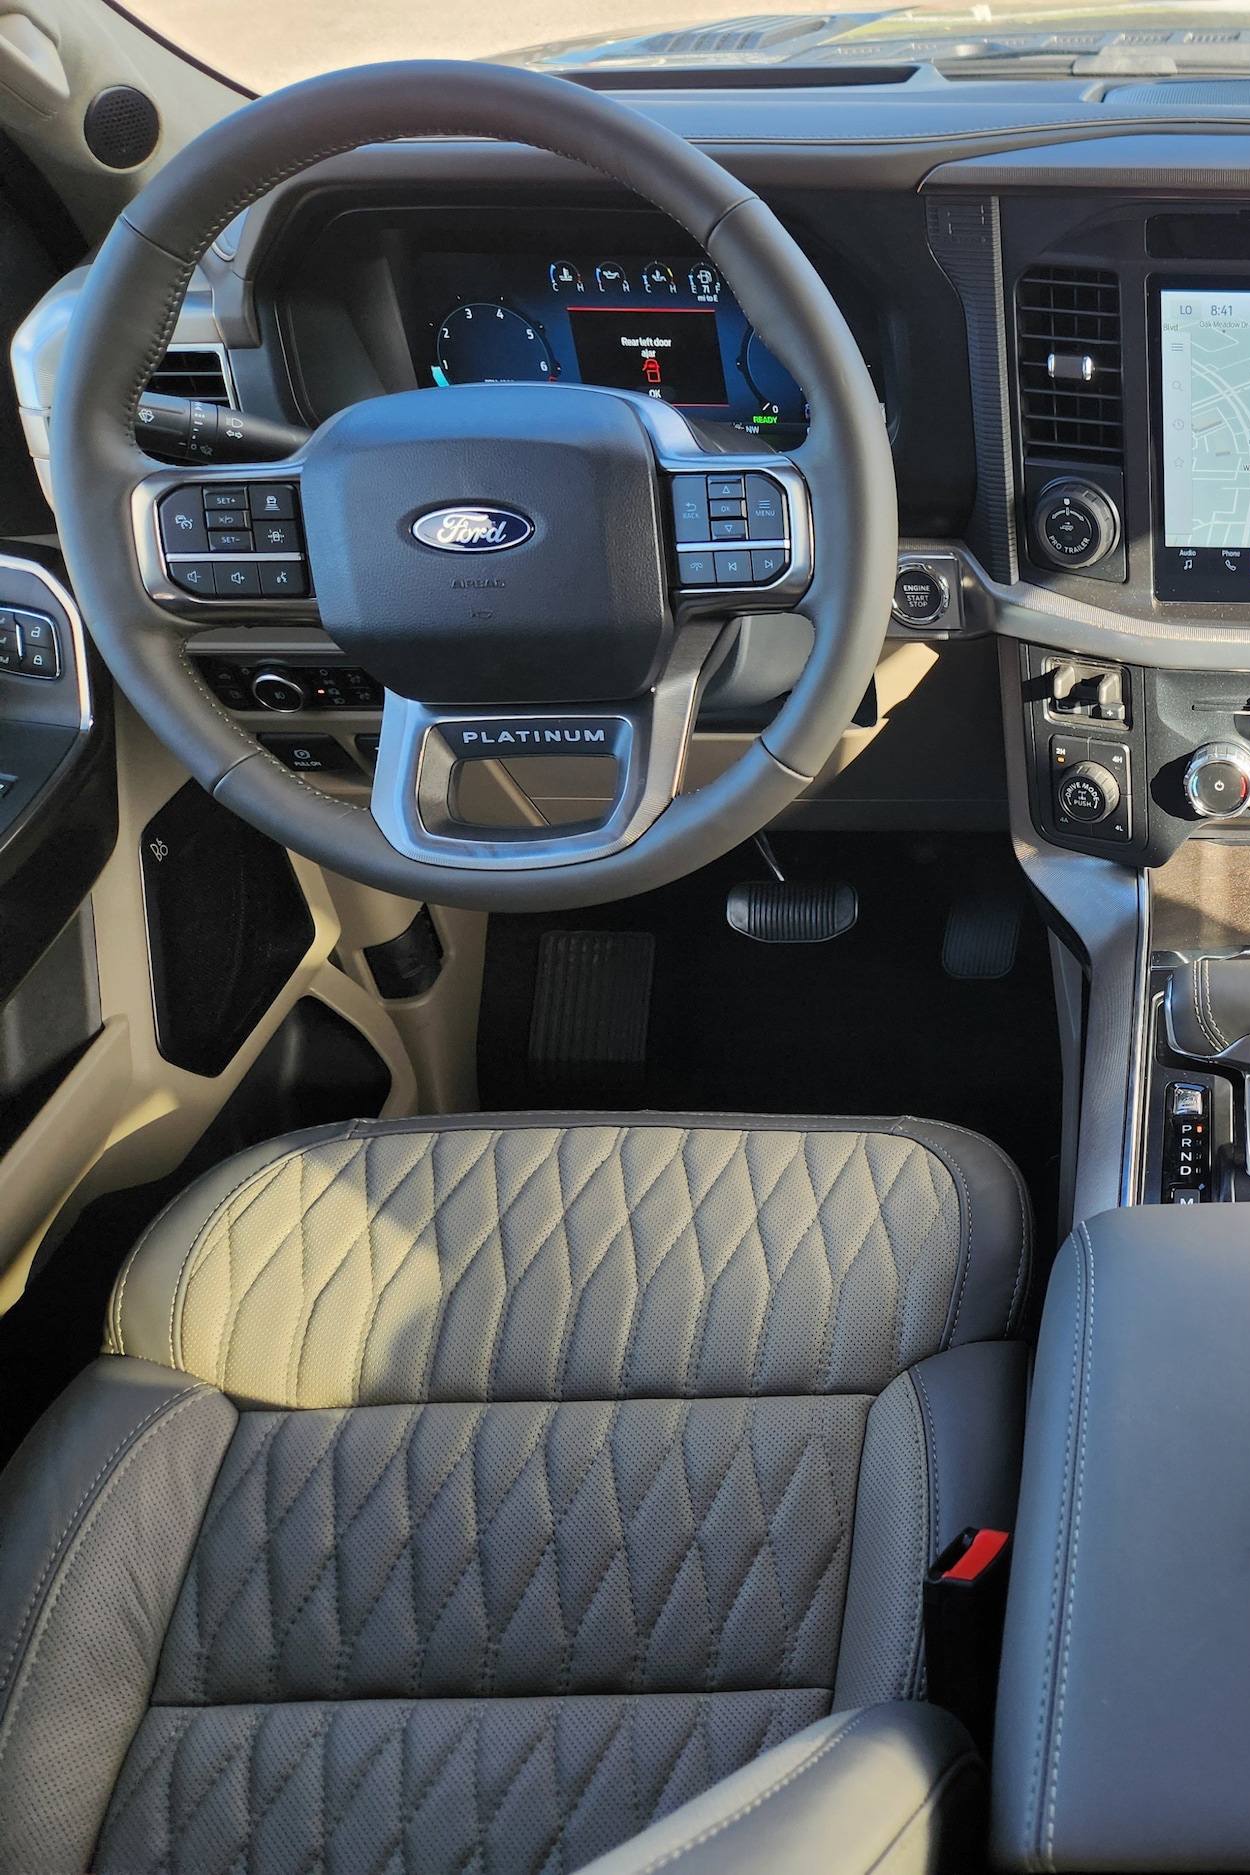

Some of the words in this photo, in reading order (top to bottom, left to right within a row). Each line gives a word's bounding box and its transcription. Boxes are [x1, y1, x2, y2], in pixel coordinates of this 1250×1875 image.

[552, 284, 559, 292] C
[577, 284, 585, 292] H
[645, 284, 652, 293] C
[669, 284, 677, 293] H
[691, 285, 697, 294] E
[465, 308, 473, 319] 3
[496, 308, 504, 319] 4
[1179, 305, 1193, 315] LO
[1210, 305, 1233, 316] 8:41
[1200, 320, 1212, 328] Oak
[1213, 321, 1240, 329] Meadow
[442, 328, 450, 339] 2
[526, 329, 534, 340] 5
[620, 337, 639, 347] Rear
[639, 337, 654, 347] left
[654, 337, 672, 347] door
[641, 348, 656, 358] ajar
[442, 359, 449, 370] 1
[540, 361, 548, 372] 6
[648, 389, 662, 398] OK
[772, 405, 779, 414] 0
[753, 416, 778, 424] READY
[745, 425, 760, 434] NW
[437, 514, 507, 544] Ford
[1049, 535, 1062, 550] PRO
[1064, 537, 1091, 554] TRAILER
[1179, 549, 1197, 557] Audio
[903, 584, 930, 592] ENGINE
[462, 729, 606, 744] PLATINUM
[1055, 747, 1066, 755] 2H
[1112, 755, 1123, 764] 4H
[1065, 781, 1081, 798] DRIVE
[1082, 782, 1100, 802] MODE
[1073, 799, 1092, 808] PUSH
[1181, 1124, 1193, 1134] P
[1181, 1138, 1192, 1148] R
[1180, 1151, 1192, 1162] N
[1180, 1165, 1192, 1176] D
